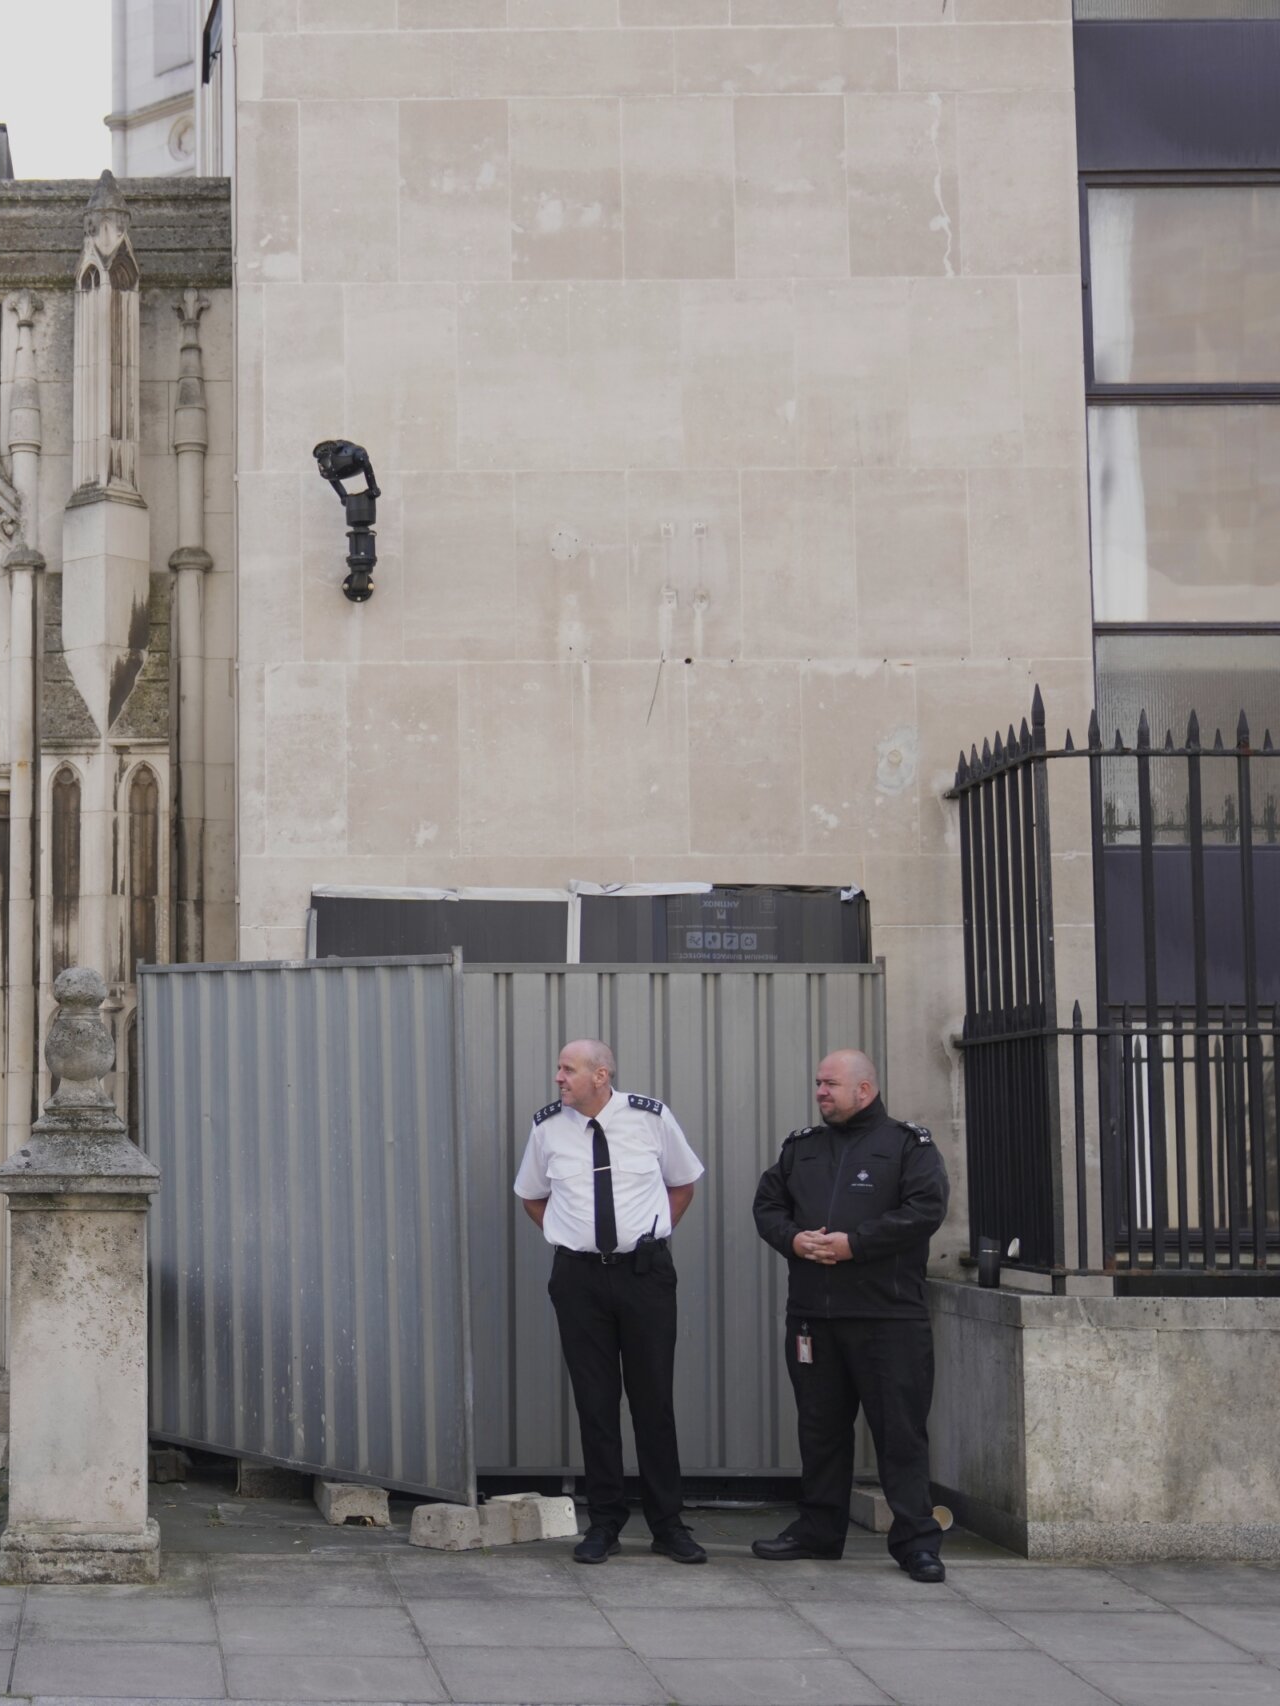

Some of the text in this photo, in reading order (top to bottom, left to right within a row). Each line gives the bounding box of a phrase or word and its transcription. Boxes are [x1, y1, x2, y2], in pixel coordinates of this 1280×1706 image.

[702, 900, 739, 908] ANTINOX
[712, 952, 743, 960] SURFACE
[744, 952, 778, 960] PREMIUM
